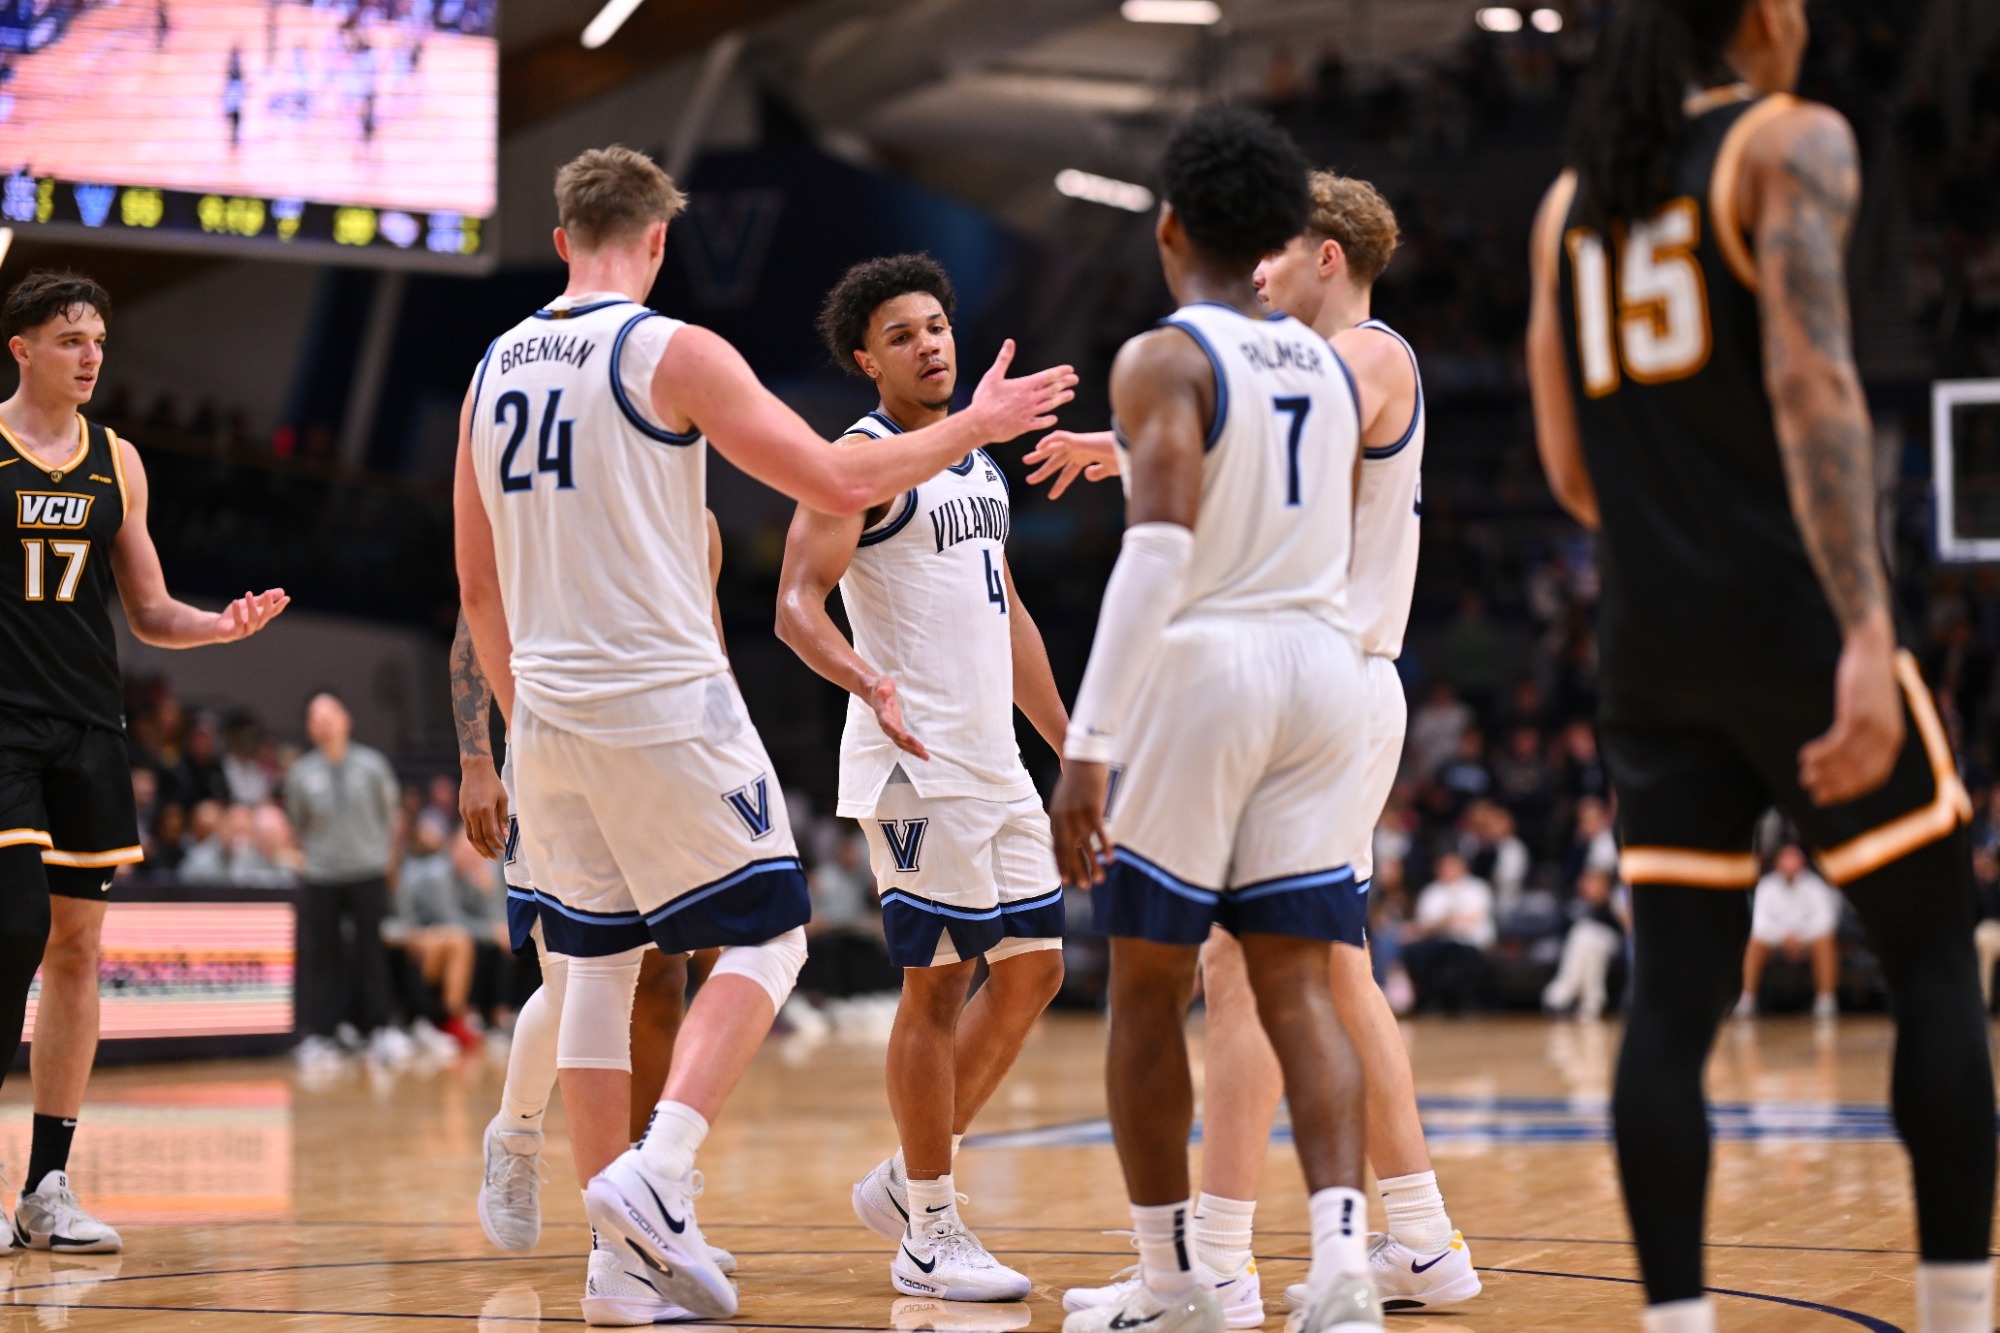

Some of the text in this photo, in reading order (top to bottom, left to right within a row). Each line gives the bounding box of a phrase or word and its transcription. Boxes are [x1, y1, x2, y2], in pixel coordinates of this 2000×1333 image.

[1565, 197, 1712, 398] 15
[501, 334, 596, 375] BRENNAN
[494, 387, 577, 494] 24
[1271, 395, 1312, 508] 7
[20, 493, 90, 526] VCU
[21, 539, 91, 602] 17
[982, 549, 1007, 614] 4
[721, 773, 774, 841] V
[878, 817, 929, 872] V
